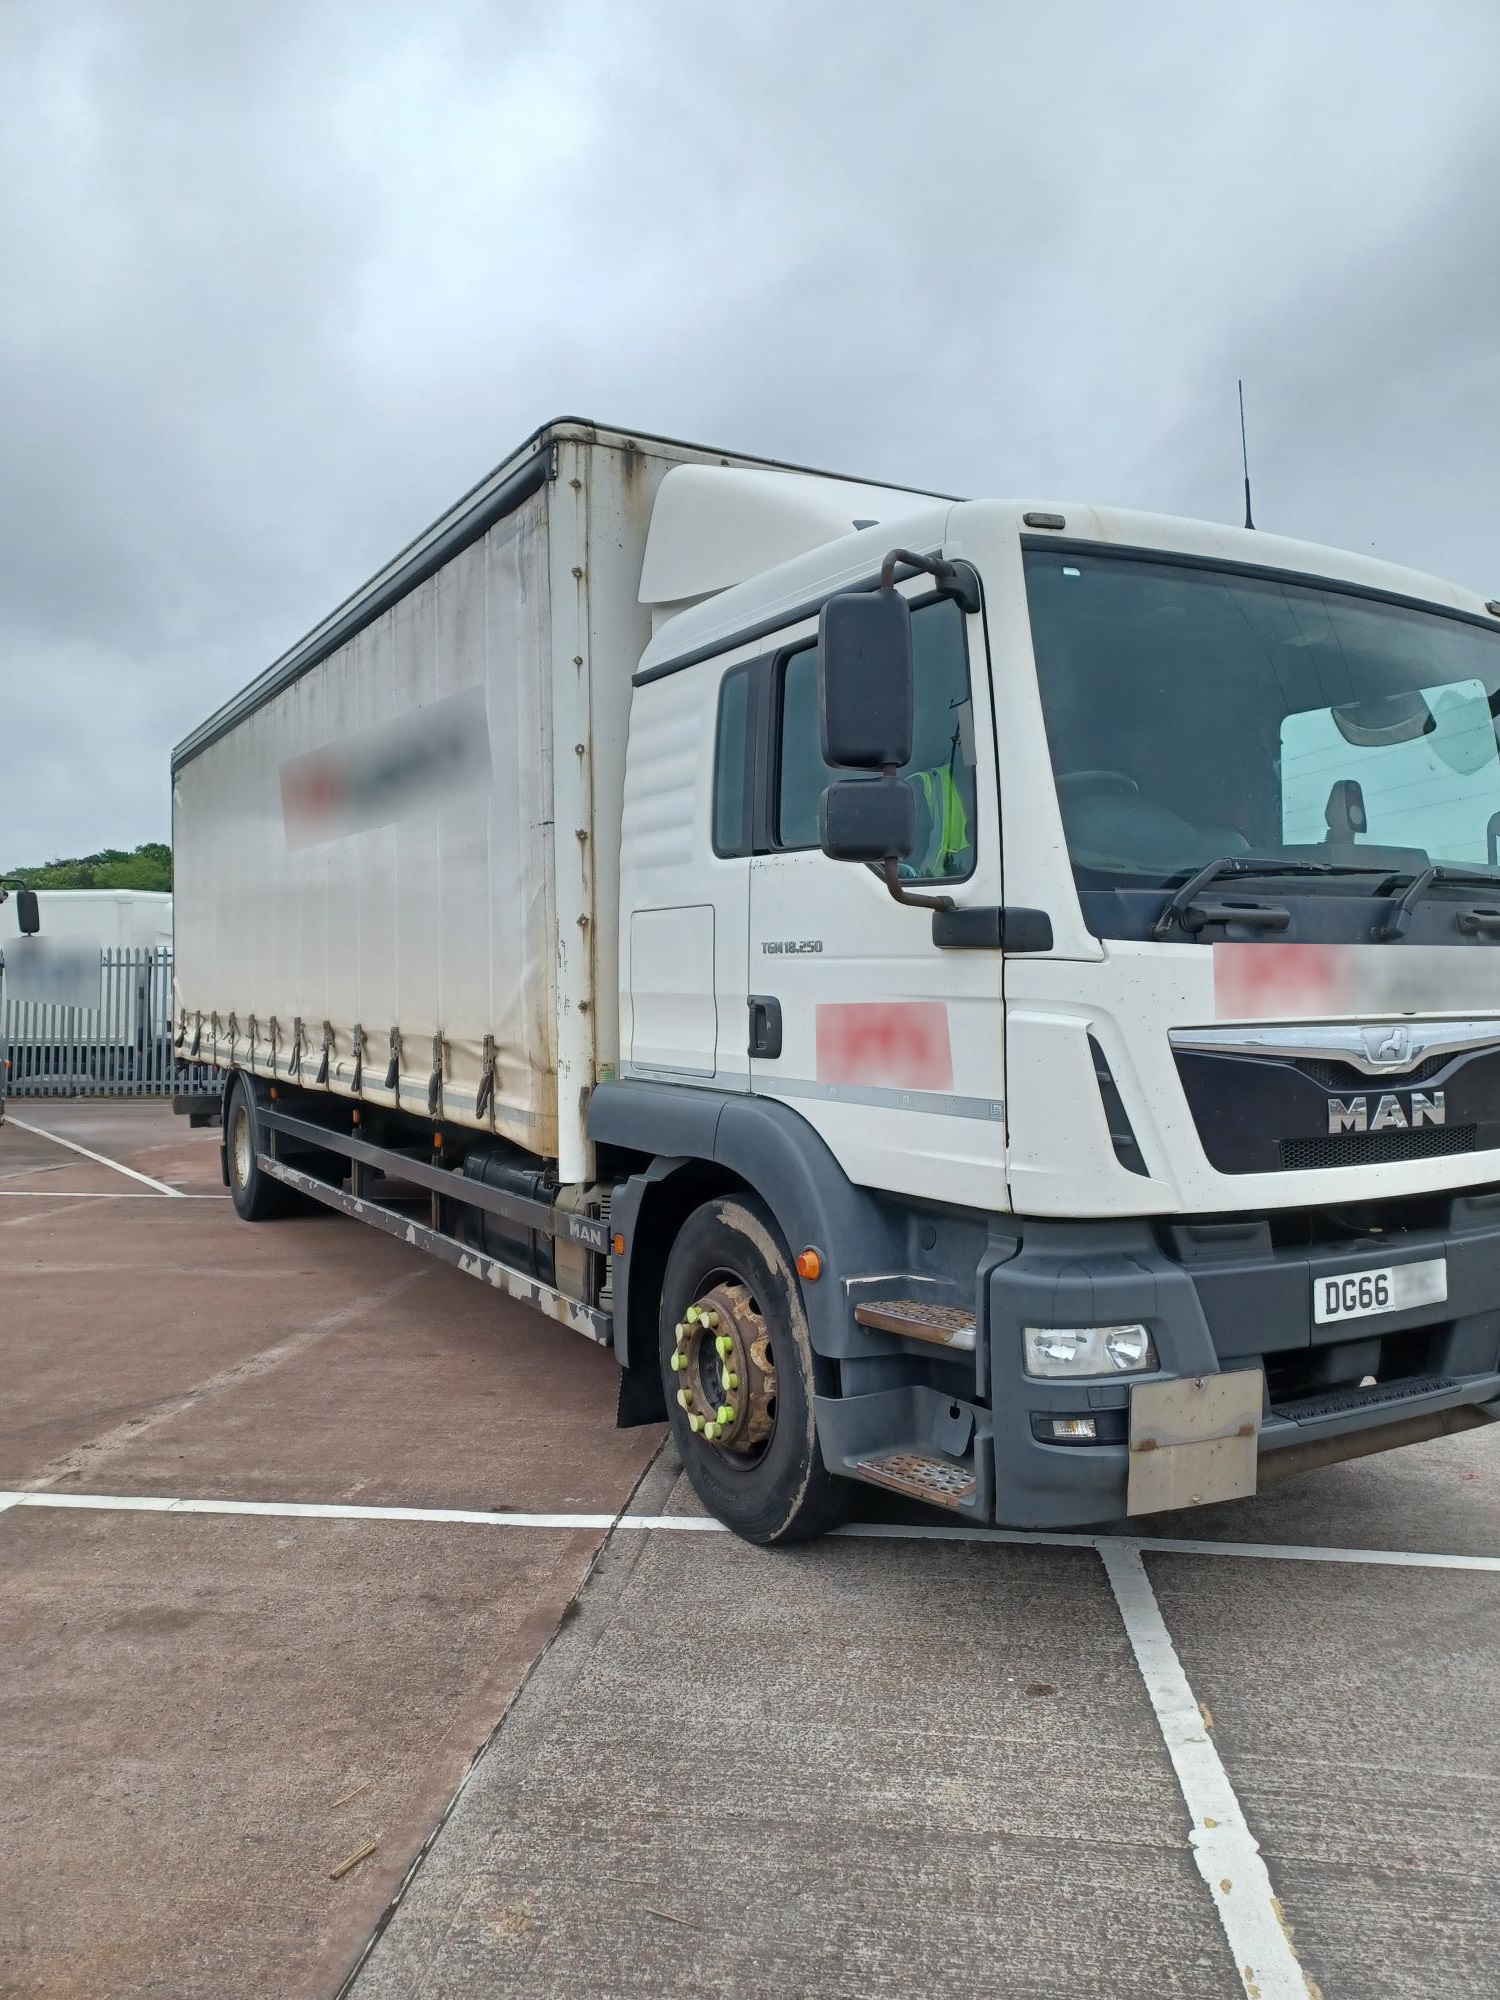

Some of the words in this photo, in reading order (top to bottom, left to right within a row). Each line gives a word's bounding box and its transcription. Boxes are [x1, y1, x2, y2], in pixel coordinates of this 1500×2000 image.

[761, 941, 783, 954] TGM
[784, 940, 823, 954] 18.250
[1327, 1091, 1446, 1134] MAN
[569, 1219, 602, 1246] MAN
[1325, 1273, 1389, 1315] DG66
